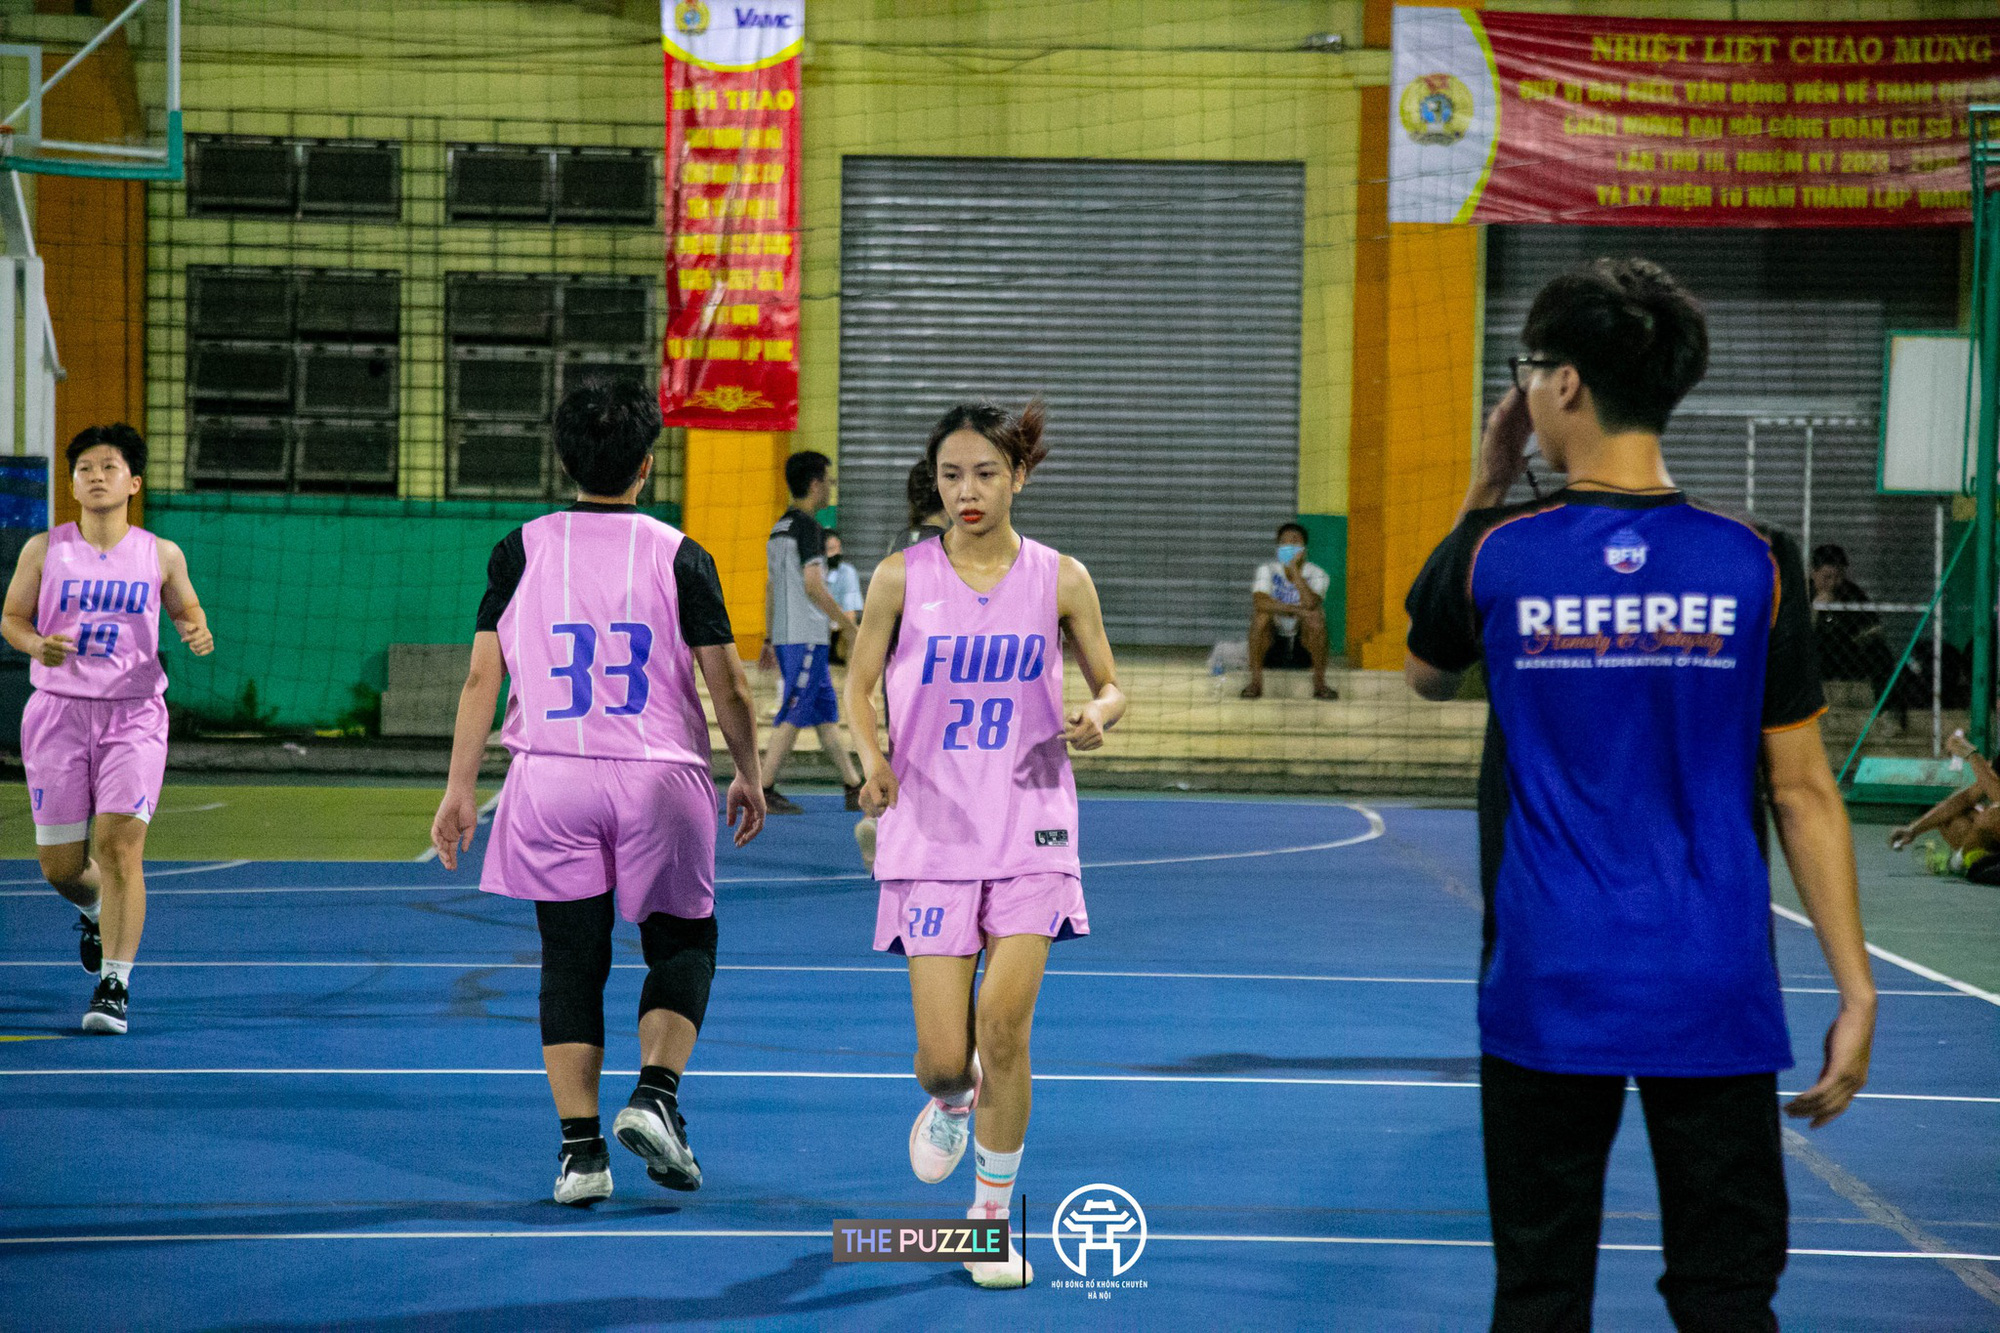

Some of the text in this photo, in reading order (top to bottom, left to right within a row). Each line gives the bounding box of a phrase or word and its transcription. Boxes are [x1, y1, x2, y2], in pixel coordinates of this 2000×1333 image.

[60, 580, 150, 615] FUDO
[1518, 595, 1737, 636] REFEREE
[77, 623, 119, 658] 19
[922, 634, 1046, 685] FUDO
[546, 622, 653, 721] 33
[1515, 658, 1593, 670] BASKETBALL
[1596, 657, 1673, 668] FEDERATION
[942, 698, 1014, 750] 28
[908, 907, 945, 938] 28
